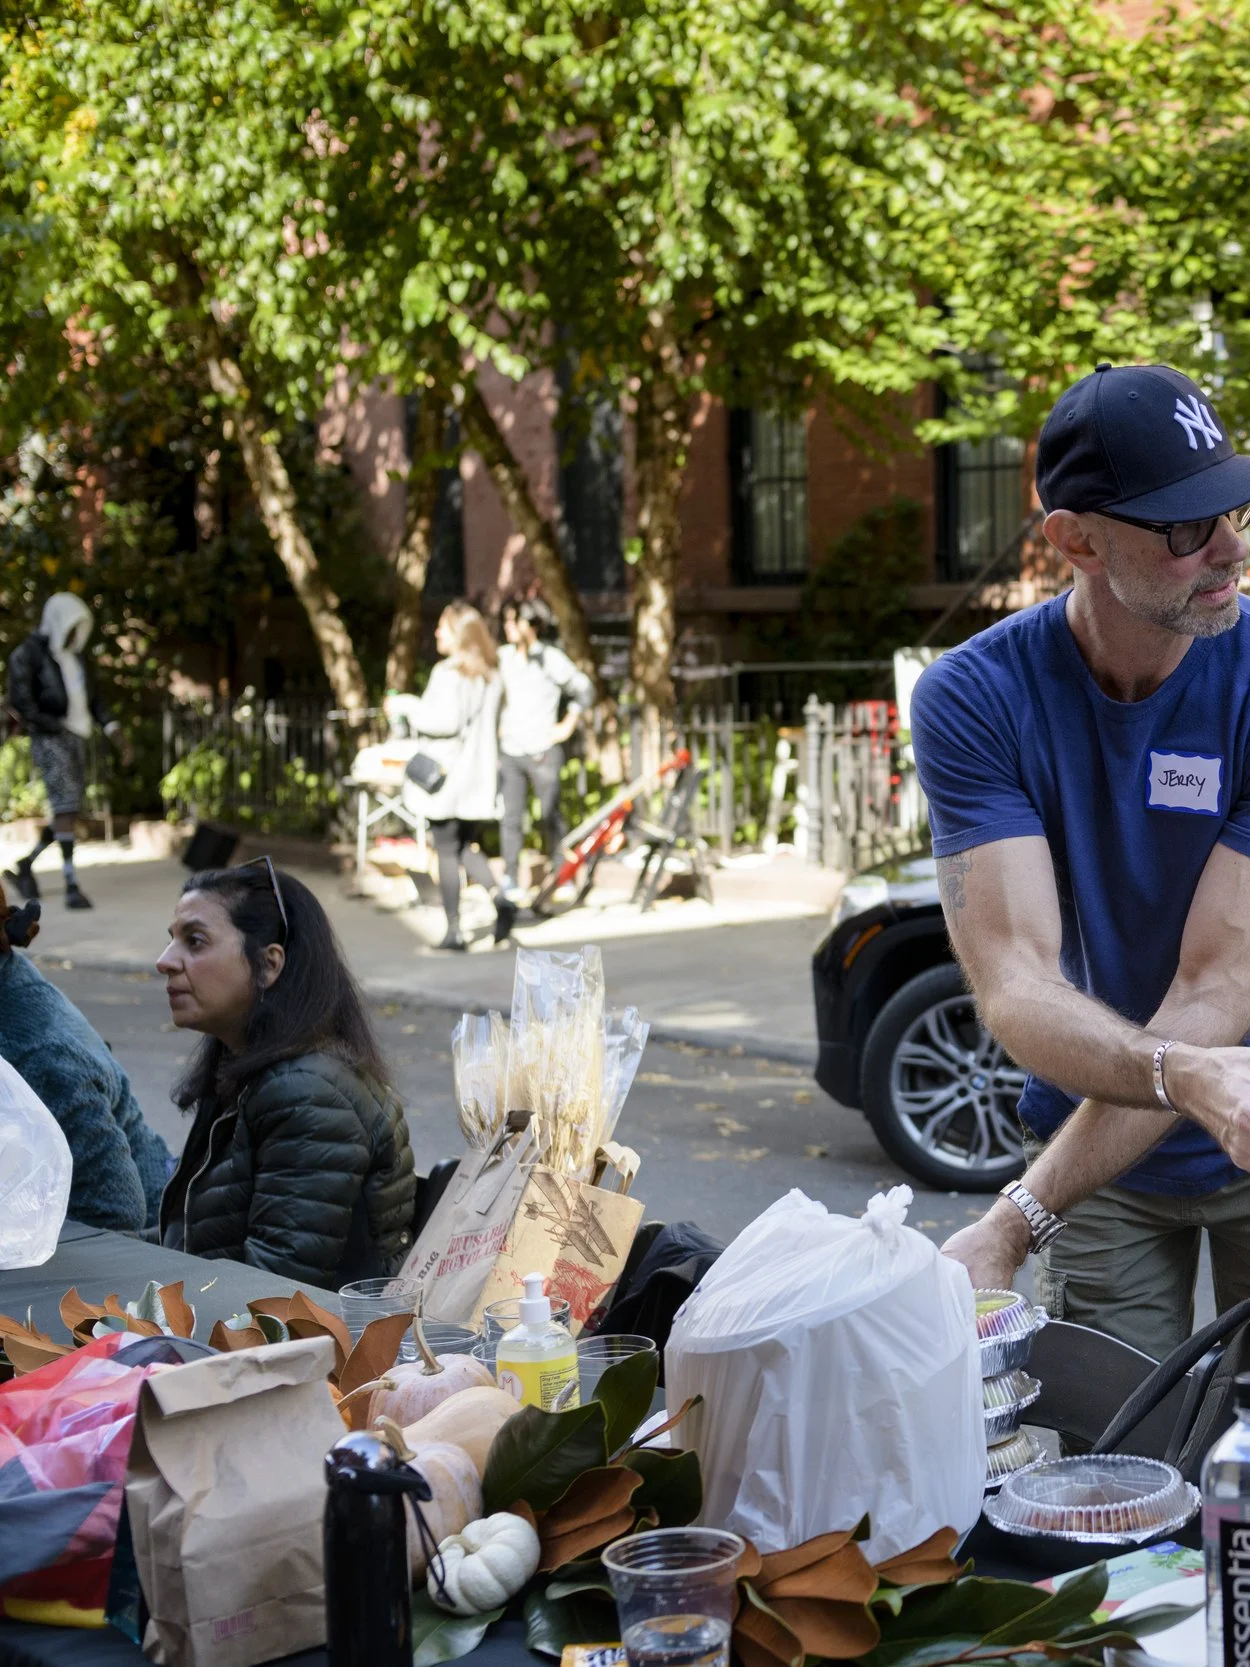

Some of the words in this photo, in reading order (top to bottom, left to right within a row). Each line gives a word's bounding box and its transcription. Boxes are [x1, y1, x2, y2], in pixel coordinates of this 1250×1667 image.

[1173, 394, 1222, 450] NY
[1158, 769, 1207, 797] JERRY
[418, 1250, 440, 1280] BAG
